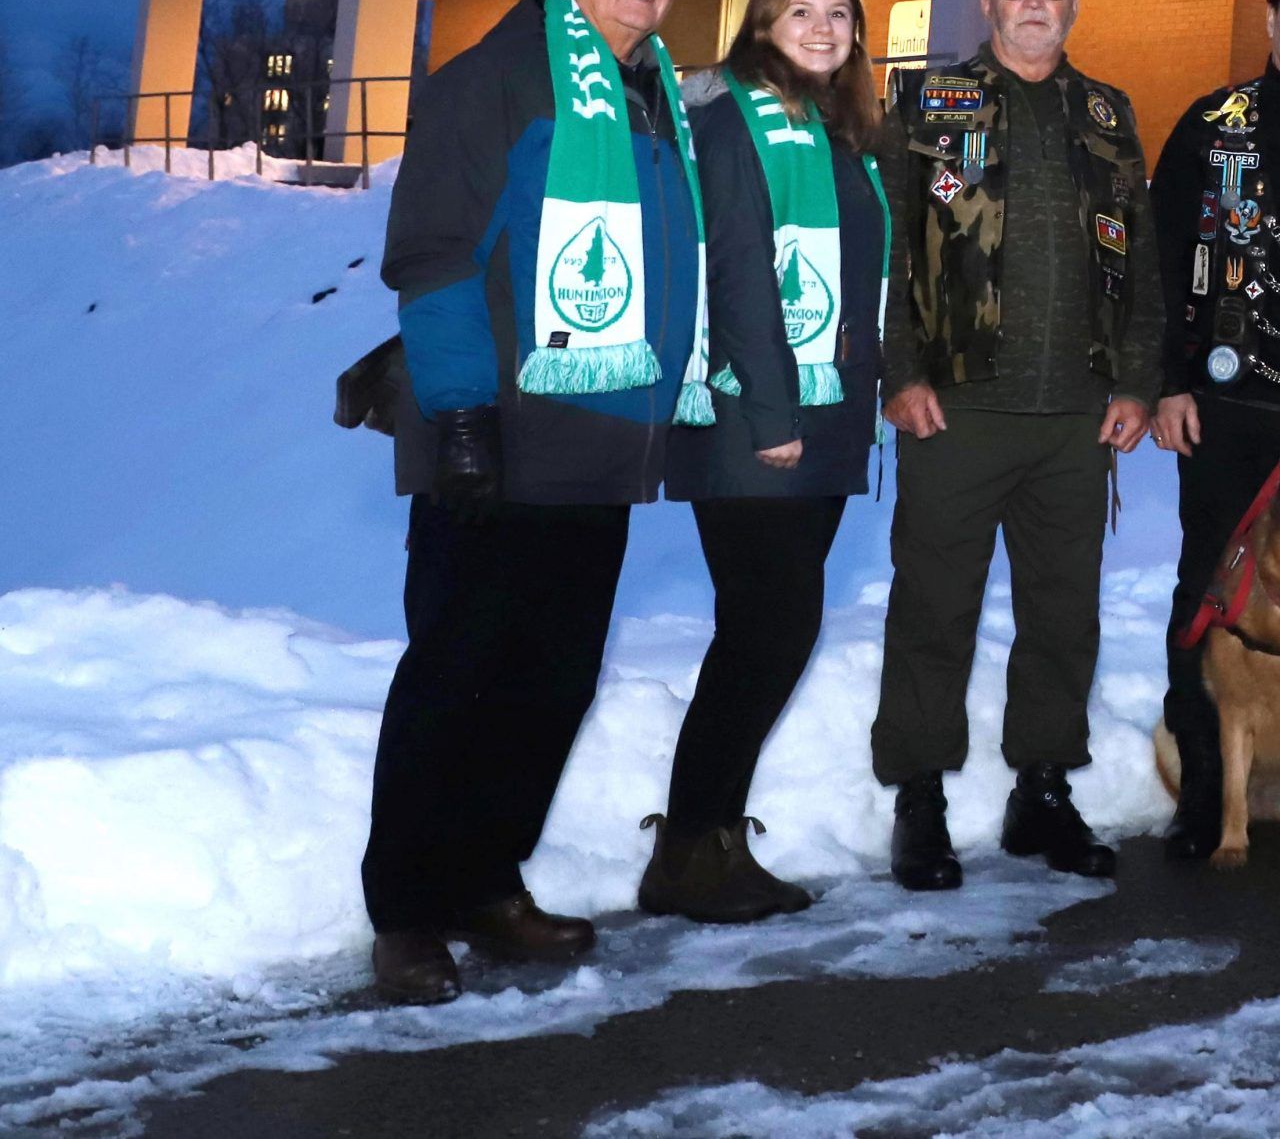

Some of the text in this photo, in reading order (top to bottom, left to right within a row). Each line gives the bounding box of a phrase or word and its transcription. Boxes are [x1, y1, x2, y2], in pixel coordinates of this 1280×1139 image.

[890, 35, 926, 53] Huntin
[925, 90, 980, 100] VETERAN
[1213, 153, 1255, 165] DRAPER
